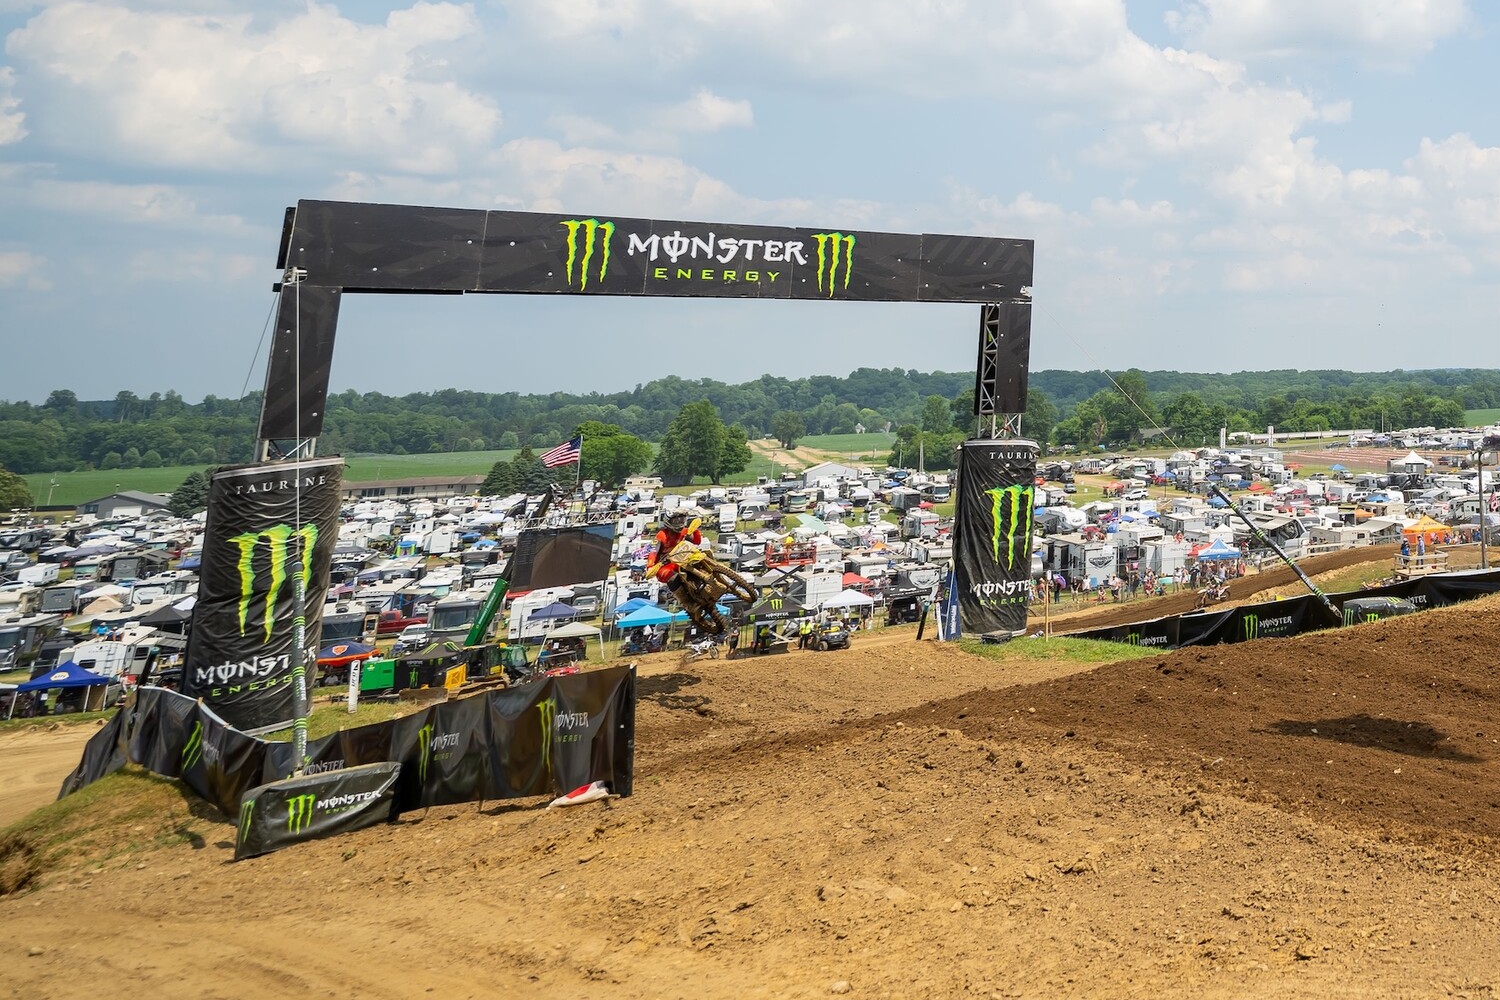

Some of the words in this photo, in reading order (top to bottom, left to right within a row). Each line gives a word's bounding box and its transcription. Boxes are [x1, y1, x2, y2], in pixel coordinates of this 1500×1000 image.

[628, 230, 807, 265] MONSTER
[654, 267, 780, 282] ENERGY
[989, 451, 1035, 460] TAURIN
[969, 580, 1030, 598] MONSTE
[1259, 615, 1292, 629] MONSTER
[1264, 626, 1288, 634] ENERGY
[1139, 635, 1168, 646] MONSTER
[212, 674, 294, 697] ENERG
[317, 790, 382, 809] MONSTER
